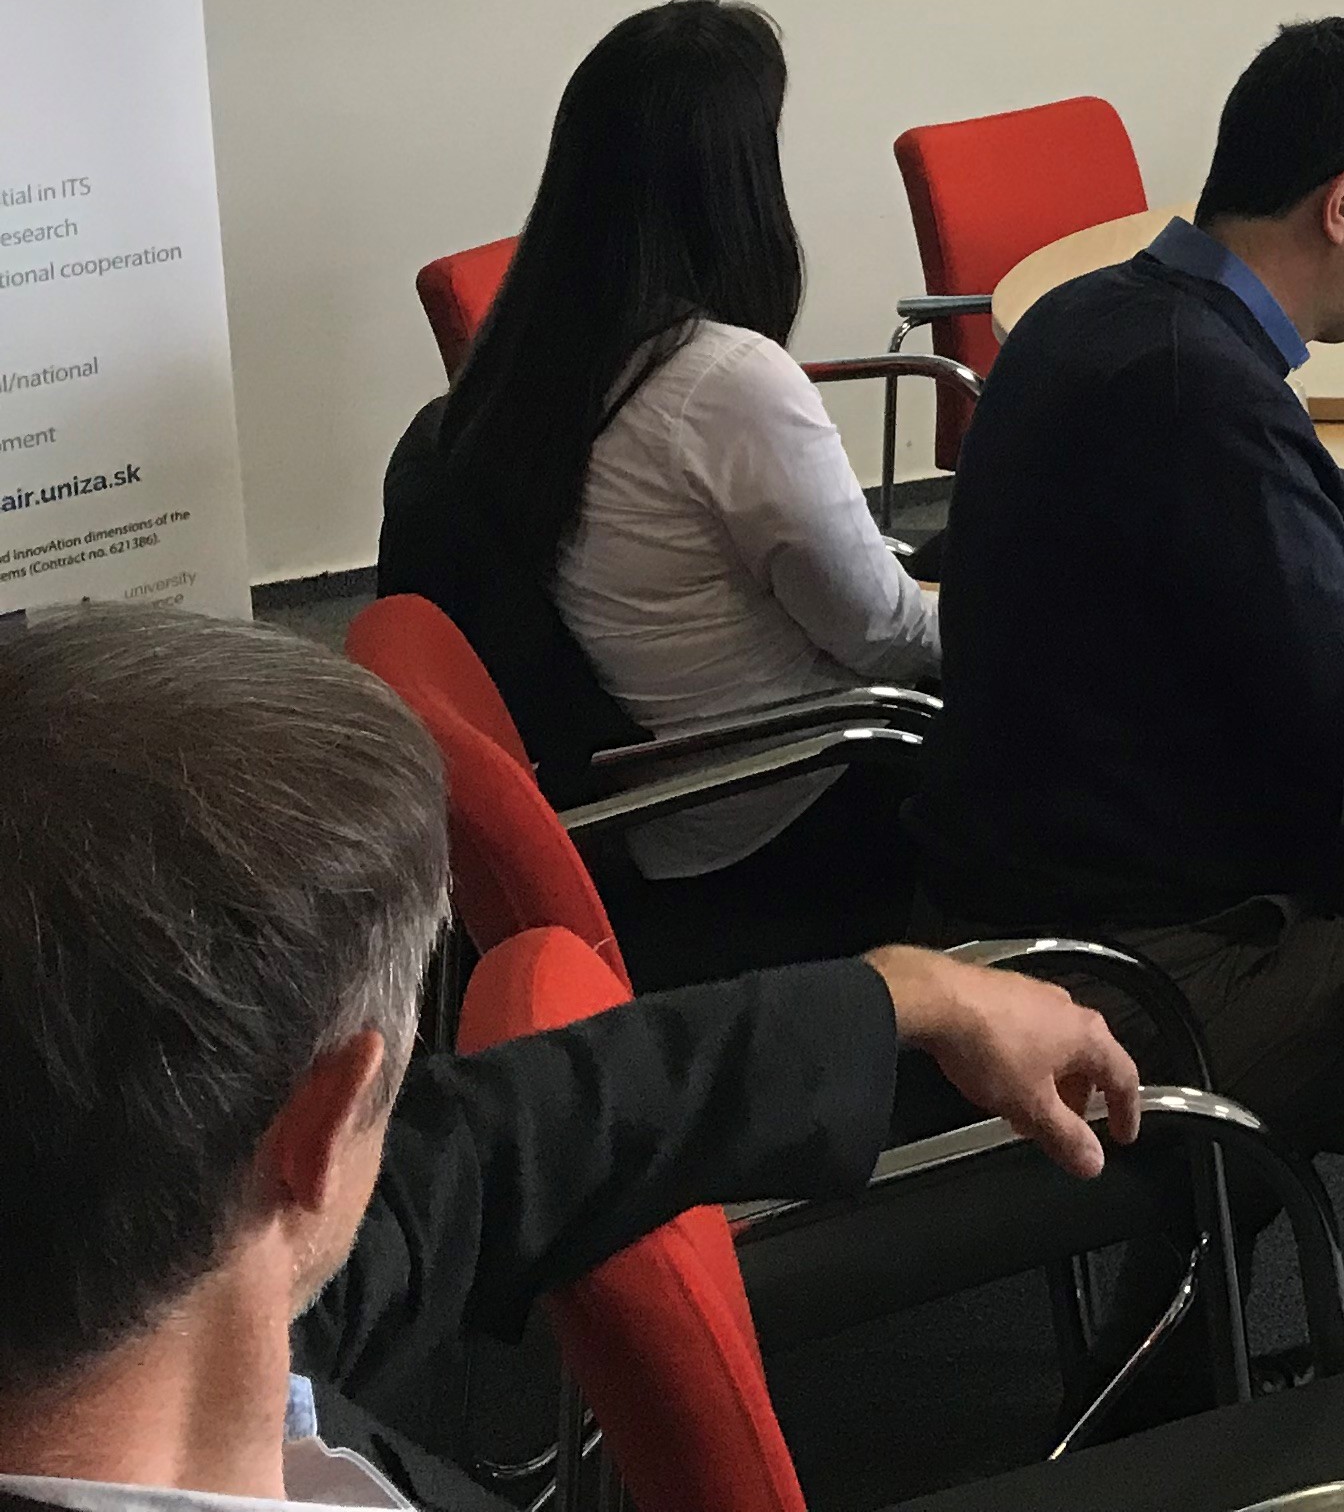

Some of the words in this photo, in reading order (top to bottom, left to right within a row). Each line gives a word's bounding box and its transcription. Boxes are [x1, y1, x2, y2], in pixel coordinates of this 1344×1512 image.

[38, 184, 56, 201] in
[62, 177, 91, 198] ITS
[0, 218, 78, 246] esearch
[60, 246, 182, 278] cooperation
[84, 519, 153, 545] dimensions
[170, 510, 190, 523] the
[29, 550, 86, 575] (Contract
[88, 548, 107, 560] no.
[124, 570, 197, 599] university
